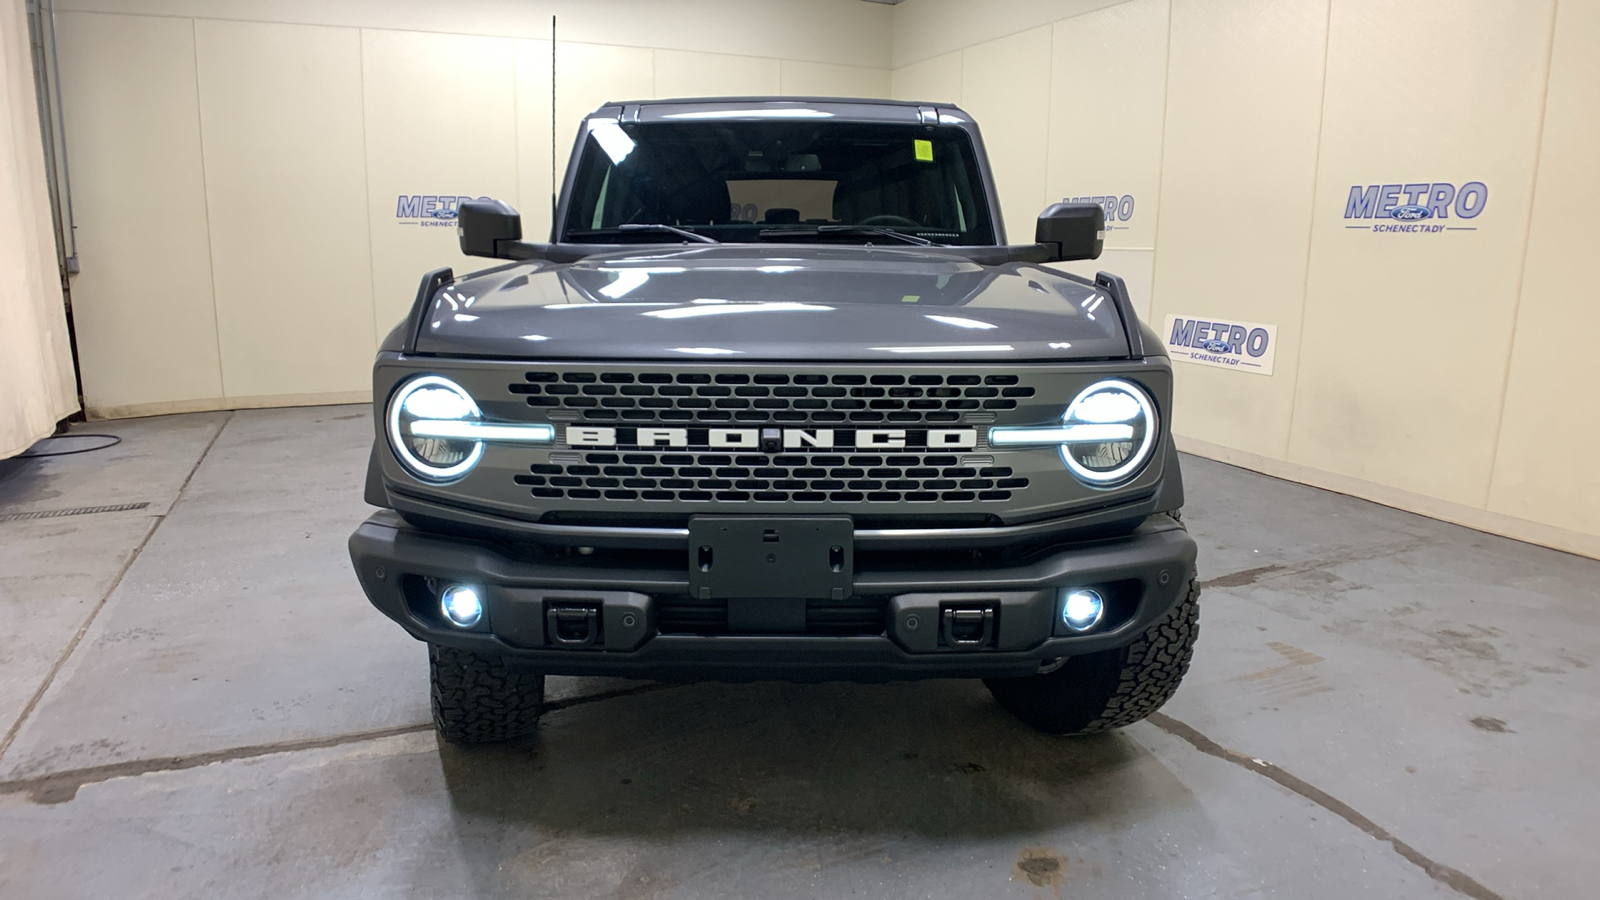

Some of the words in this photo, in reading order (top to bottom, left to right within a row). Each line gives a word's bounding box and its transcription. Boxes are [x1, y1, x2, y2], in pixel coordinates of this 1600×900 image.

[396, 195, 492, 218] MET
[1344, 181, 1488, 219] METRO
[1397, 208, 1423, 220] Ford
[1372, 224, 1446, 233] SCHENECTADY
[1169, 318, 1269, 358] METRO
[1190, 352, 1240, 366] SCHENECTADY
[565, 426, 977, 448] BRONCO
